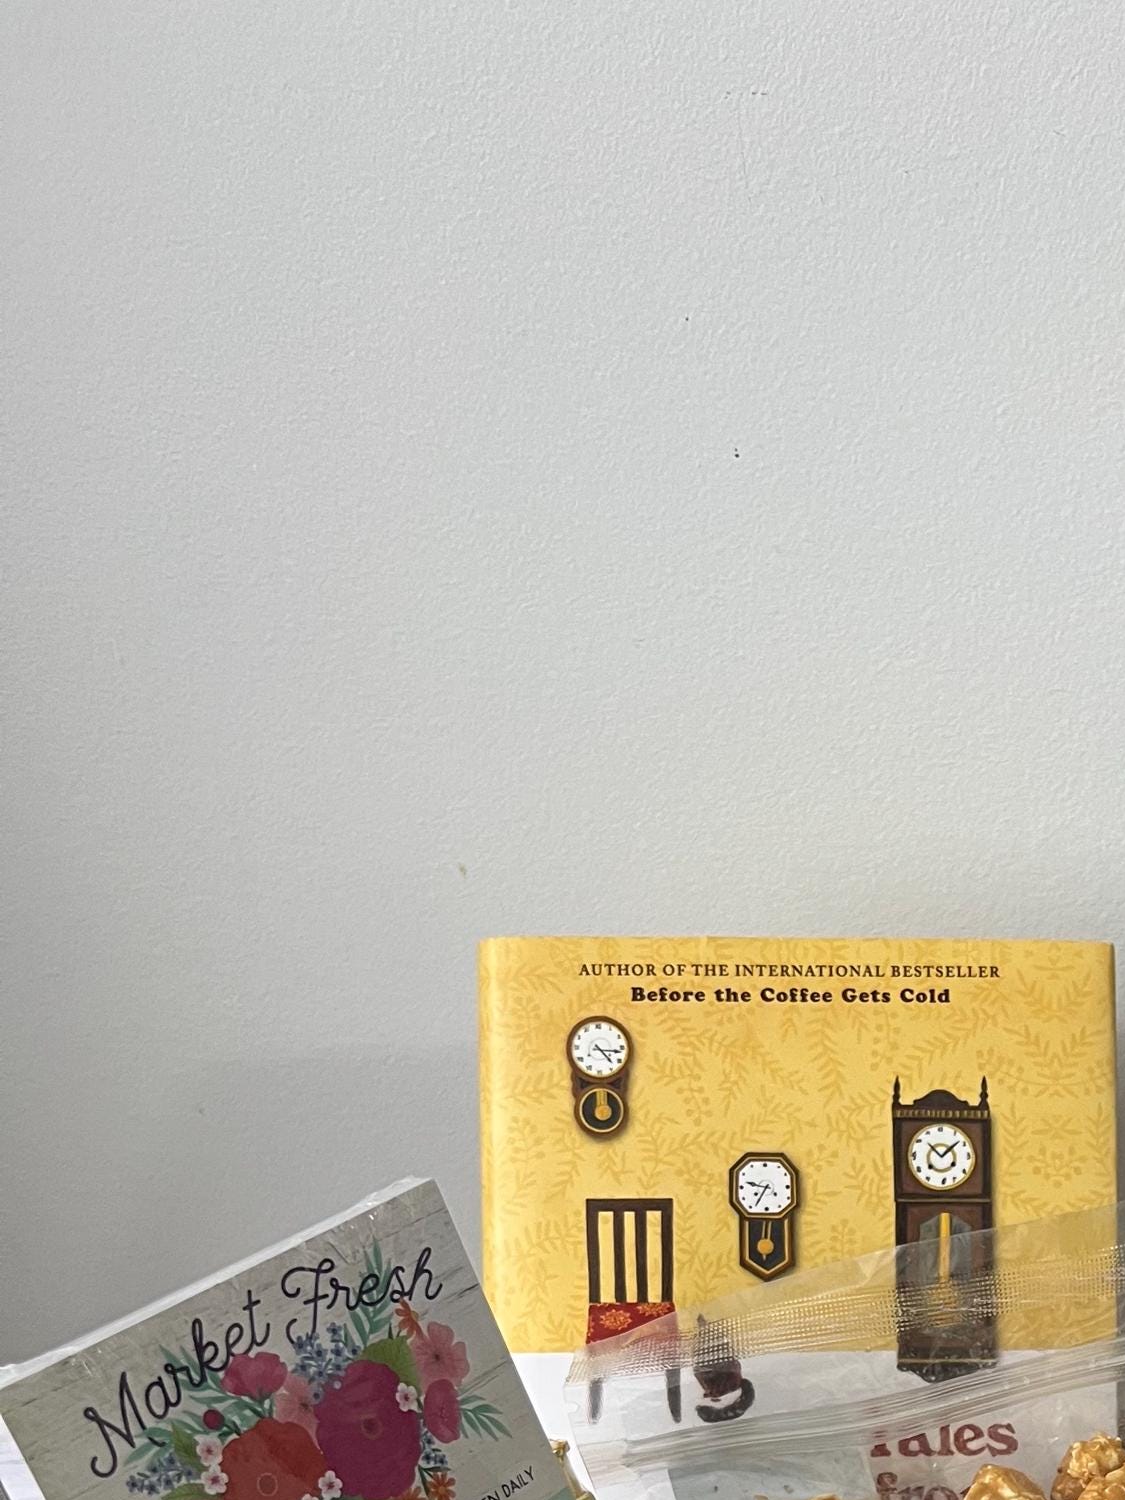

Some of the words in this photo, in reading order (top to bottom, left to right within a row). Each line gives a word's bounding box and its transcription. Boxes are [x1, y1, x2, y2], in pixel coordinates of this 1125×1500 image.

[579, 963, 657, 977] AUTHOR
[662, 963, 687, 977] OF
[691, 963, 729, 977] THE
[735, 963, 886, 978] INTERNATIONAL
[890, 964, 1001, 978] BESTSELLER
[630, 986, 706, 1003] Before
[713, 987, 752, 1003] the
[759, 987, 833, 1004] Coffee
[841, 987, 892, 1004] Gets
[899, 988, 951, 1004] Cold
[82, 1289, 271, 1478] Market
[281, 1246, 443, 1345] Fresh
[501, 1465, 535, 1499] DAILY
